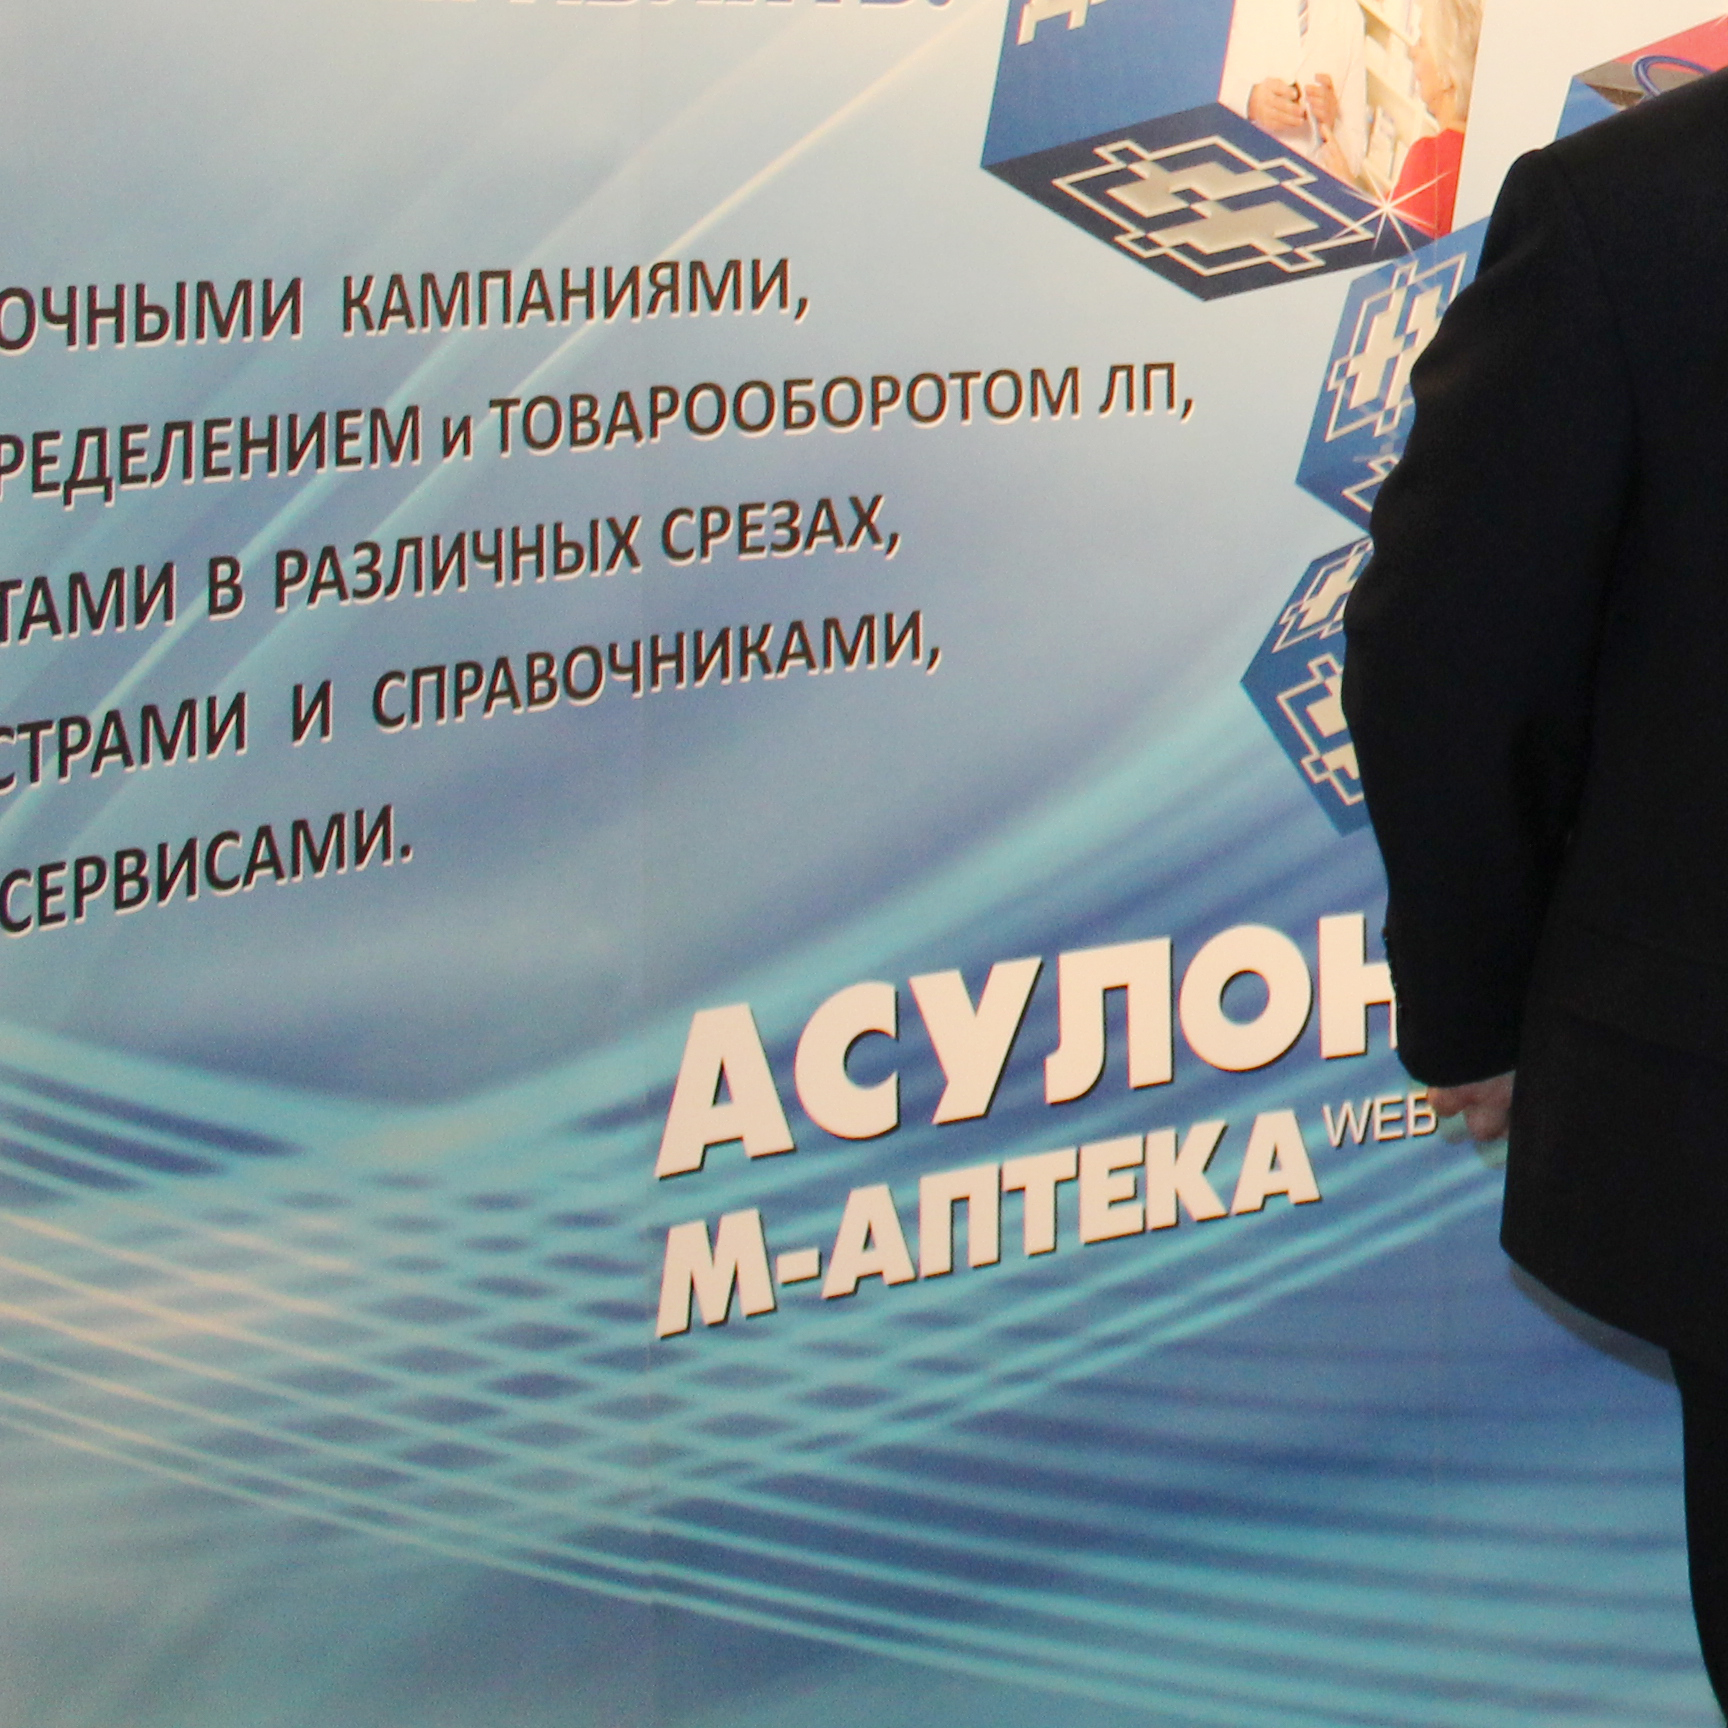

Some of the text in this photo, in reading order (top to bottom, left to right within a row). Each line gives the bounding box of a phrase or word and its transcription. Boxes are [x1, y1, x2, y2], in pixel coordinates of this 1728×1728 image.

[342, 258, 809, 336] КАМПАНИЯМИ,
[442, 415, 473, 463] и
[489, 366, 1080, 459] ТОВАРООБОРОТОМ
[1099, 362, 1196, 424] ЛП,
[208, 556, 246, 620] В
[273, 515, 642, 612] РАЗЛИЧНЫХ
[660, 494, 901, 566] СРЕЗАХ,
[292, 679, 332, 747] И
[372, 609, 942, 733] СПРАВОЧНИКАМИ,
[0, 803, 413, 939] СЕРВИСАМИ.
[655, 1109, 1322, 1340] М-АПТЕКА
